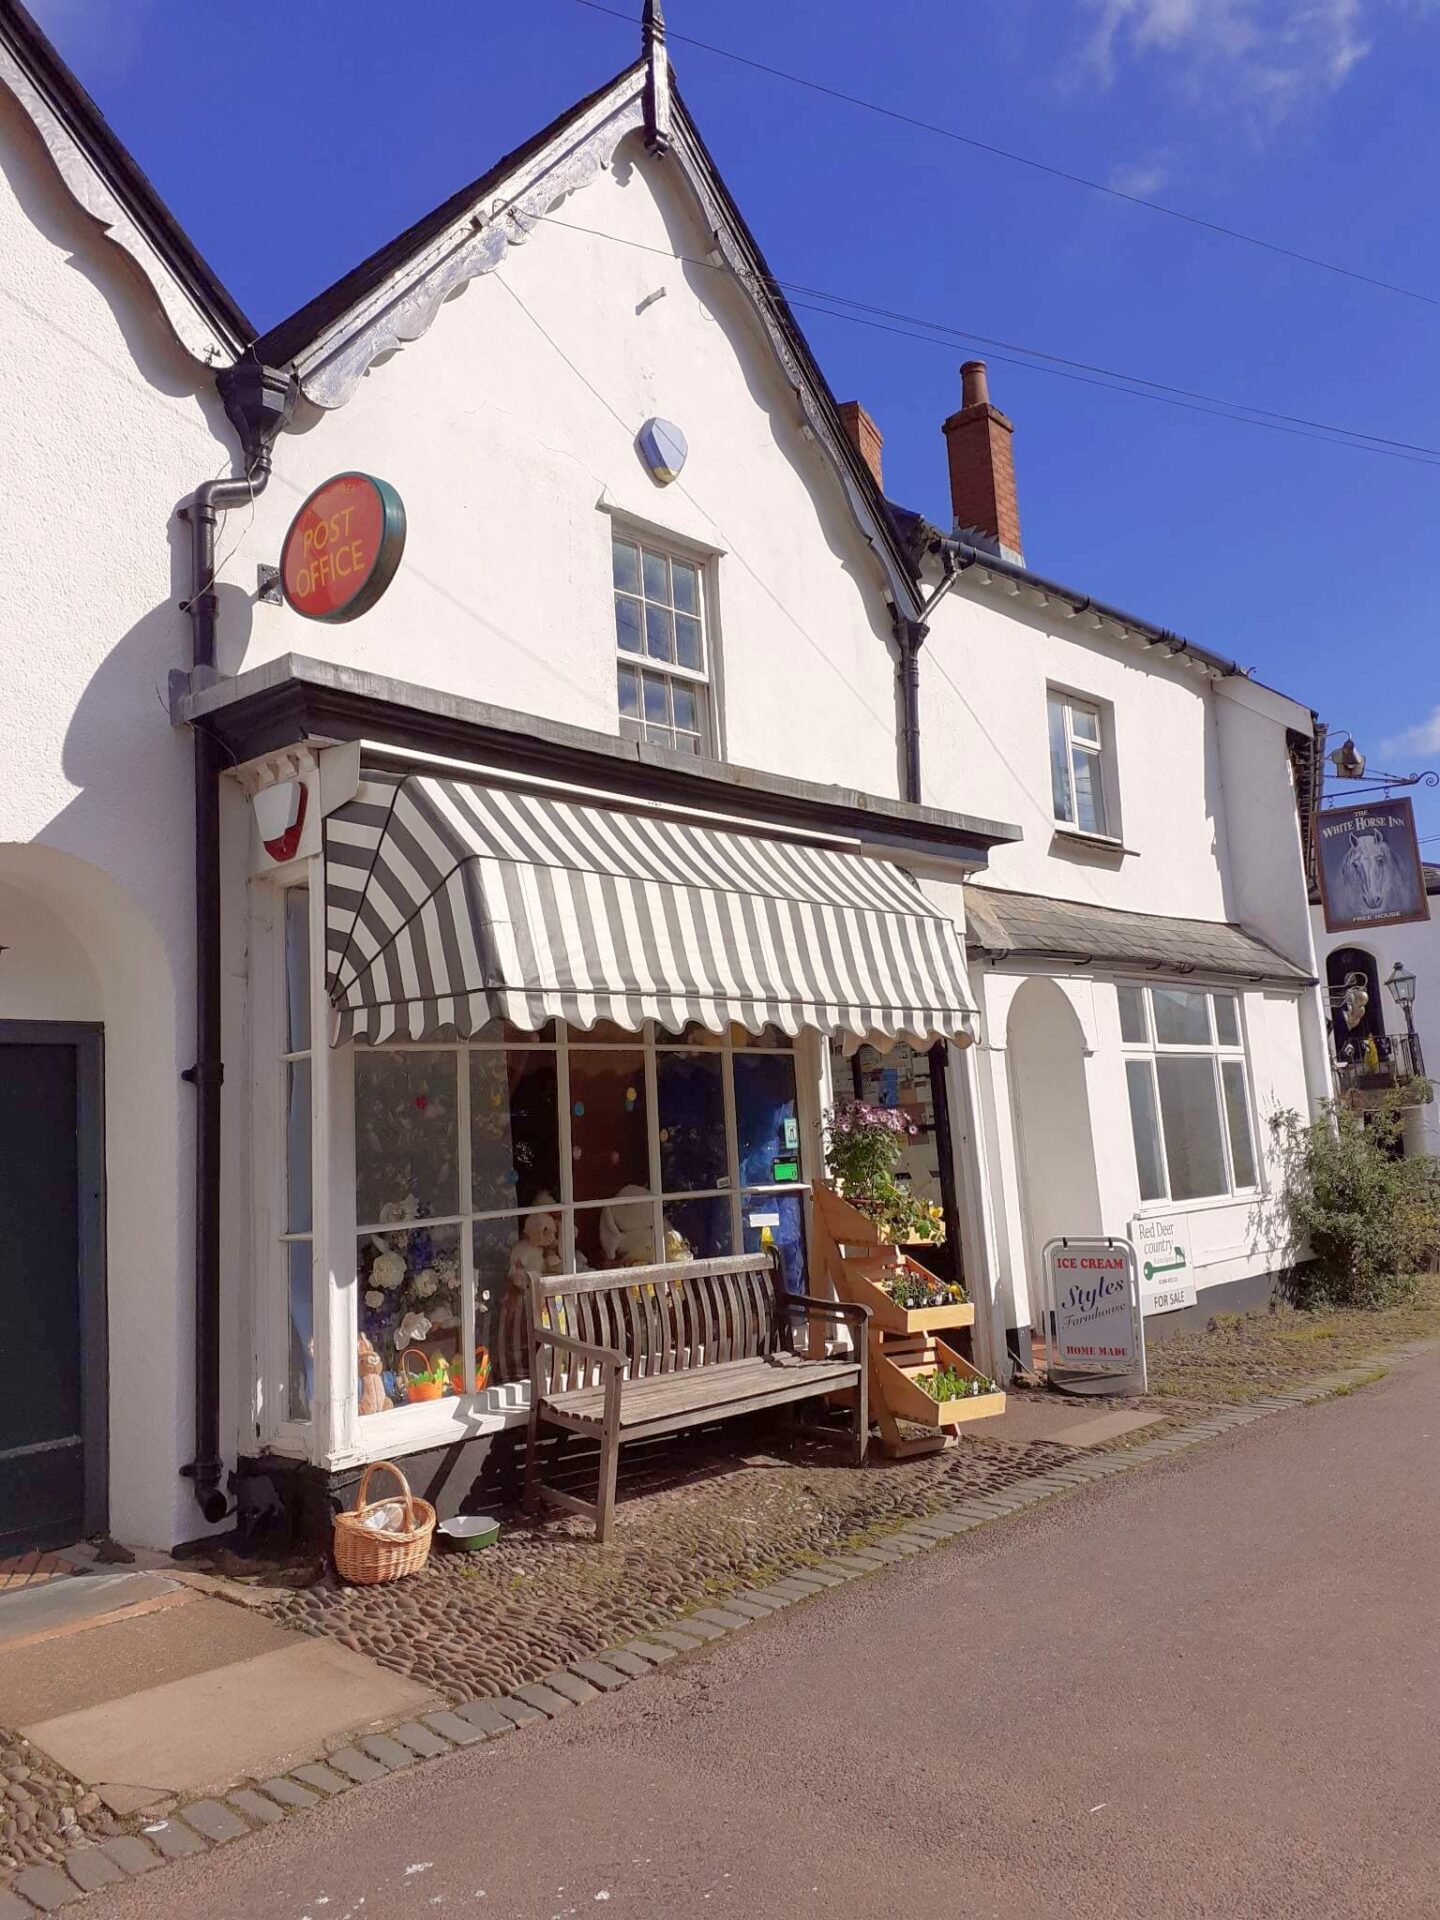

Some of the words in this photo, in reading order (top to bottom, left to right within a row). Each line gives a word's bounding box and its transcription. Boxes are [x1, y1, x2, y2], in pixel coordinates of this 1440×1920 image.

[303, 506, 354, 558] POST
[296, 539, 365, 597] OFFICE
[1354, 809, 1369, 817] THE
[1323, 820, 1354, 838] WHITE
[1355, 816, 1387, 831] HORSE
[1388, 816, 1405, 828] INN
[1138, 1221, 1155, 1240] Red
[1156, 1221, 1174, 1238] Deer
[1143, 1239, 1174, 1255] country
[1056, 1258, 1077, 1269] ICE
[1080, 1258, 1124, 1269] CREAM
[1061, 1276, 1124, 1313] Styles
[1154, 1295, 1169, 1309] FOR
[1169, 1290, 1185, 1306] SALE
[1062, 1302, 1126, 1330] Farmhouse
[1066, 1345, 1096, 1356] HOME
[1098, 1346, 1128, 1357] MADE
